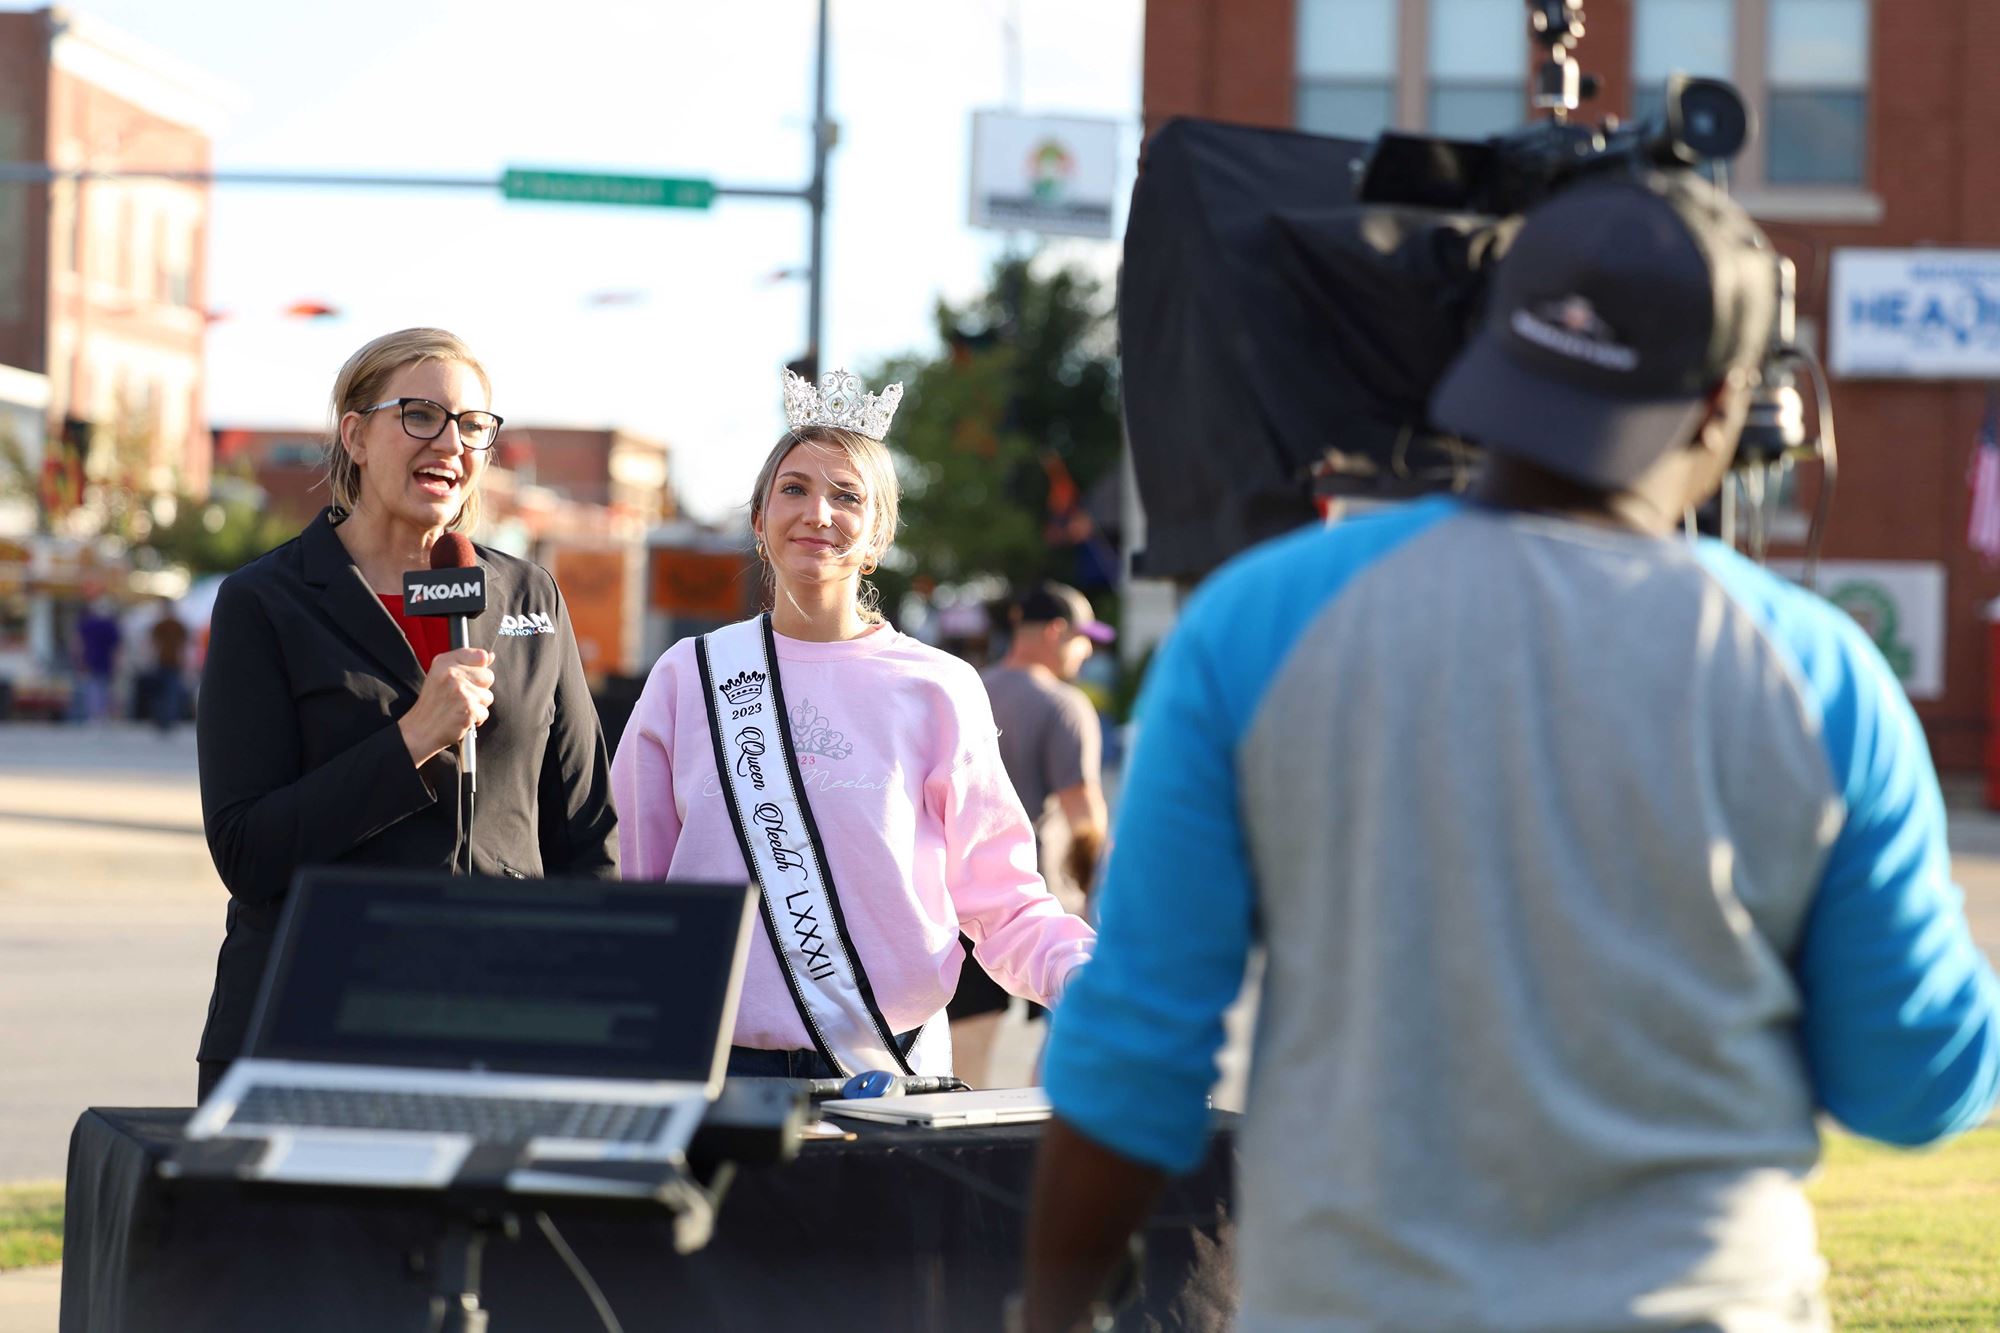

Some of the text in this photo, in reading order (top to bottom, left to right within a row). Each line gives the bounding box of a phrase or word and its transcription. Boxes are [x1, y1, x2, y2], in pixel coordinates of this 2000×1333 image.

[501, 612, 554, 630] OAM
[498, 628, 515, 636] EWS
[732, 703, 762, 720] 2023
[797, 755, 816, 766] 23
[735, 726, 835, 981] Queen Neelah LXXXII
